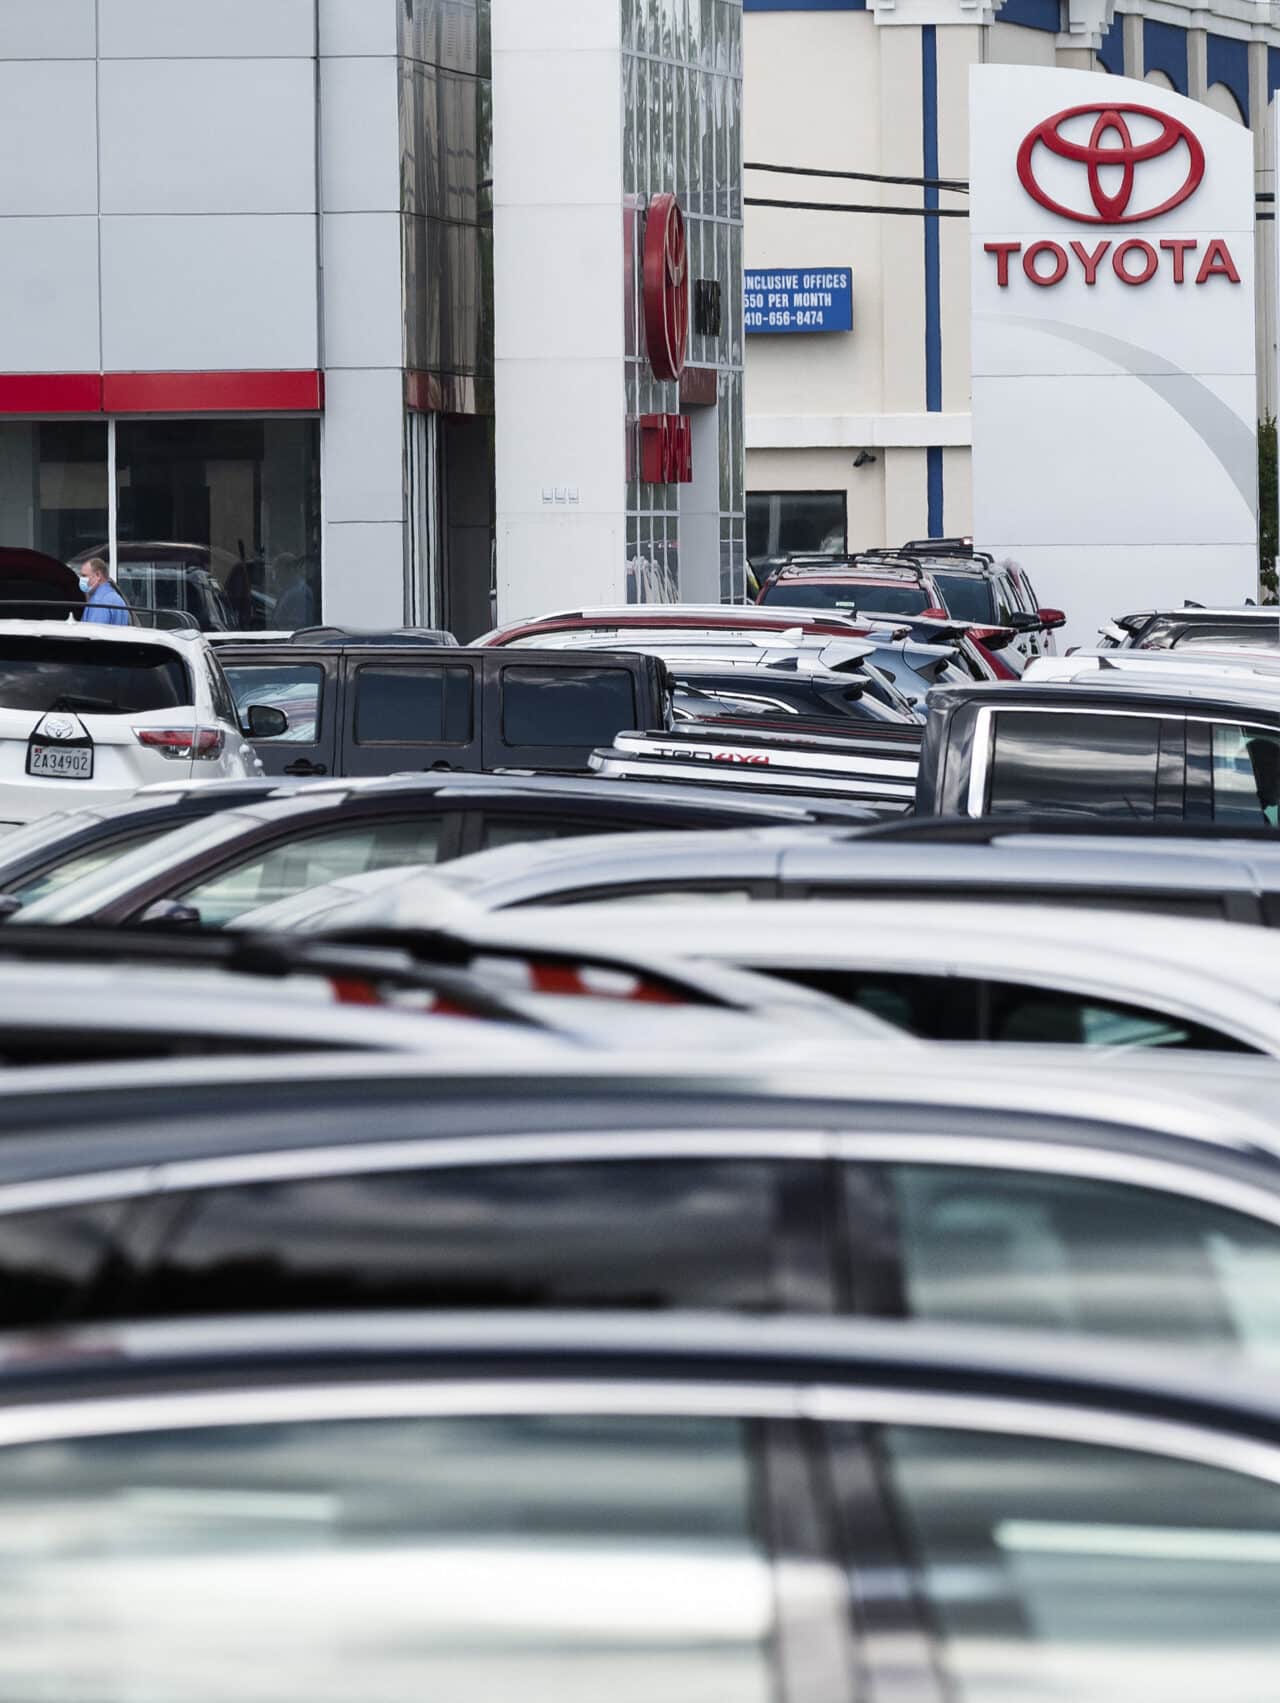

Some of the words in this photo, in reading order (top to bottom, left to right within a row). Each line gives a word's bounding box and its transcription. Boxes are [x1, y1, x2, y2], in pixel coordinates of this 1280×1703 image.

[983, 239, 1241, 286] TOYOTA
[744, 276, 799, 290] INCLUSIVE
[803, 274, 847, 289] OFFICES
[768, 294, 789, 308] PER
[793, 293, 832, 307] MONTH
[744, 311, 823, 326] 410-656-8474
[33, 753, 88, 770] 2A34902
